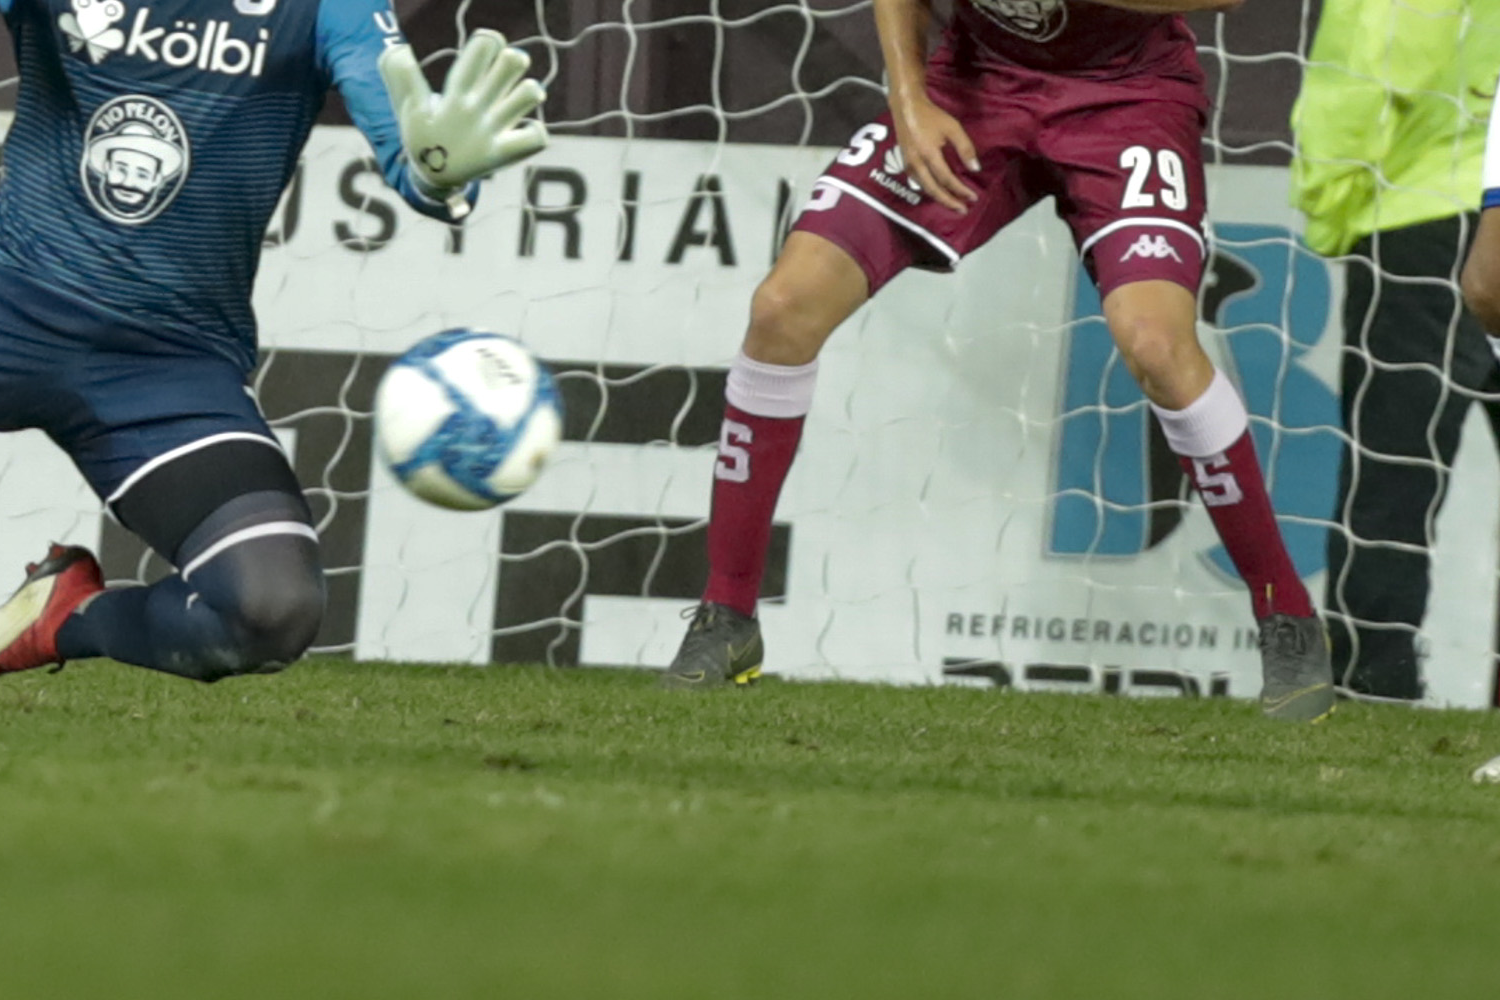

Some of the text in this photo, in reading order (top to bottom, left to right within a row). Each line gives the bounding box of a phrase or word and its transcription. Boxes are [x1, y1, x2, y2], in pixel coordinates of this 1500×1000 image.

[124, 6, 270, 77] kölbi
[837, 122, 889, 167] S
[1118, 144, 1189, 212] 29
[715, 419, 754, 484] S
[1192, 454, 1244, 508] S
[945, 612, 1218, 649] REFRIGERACION
